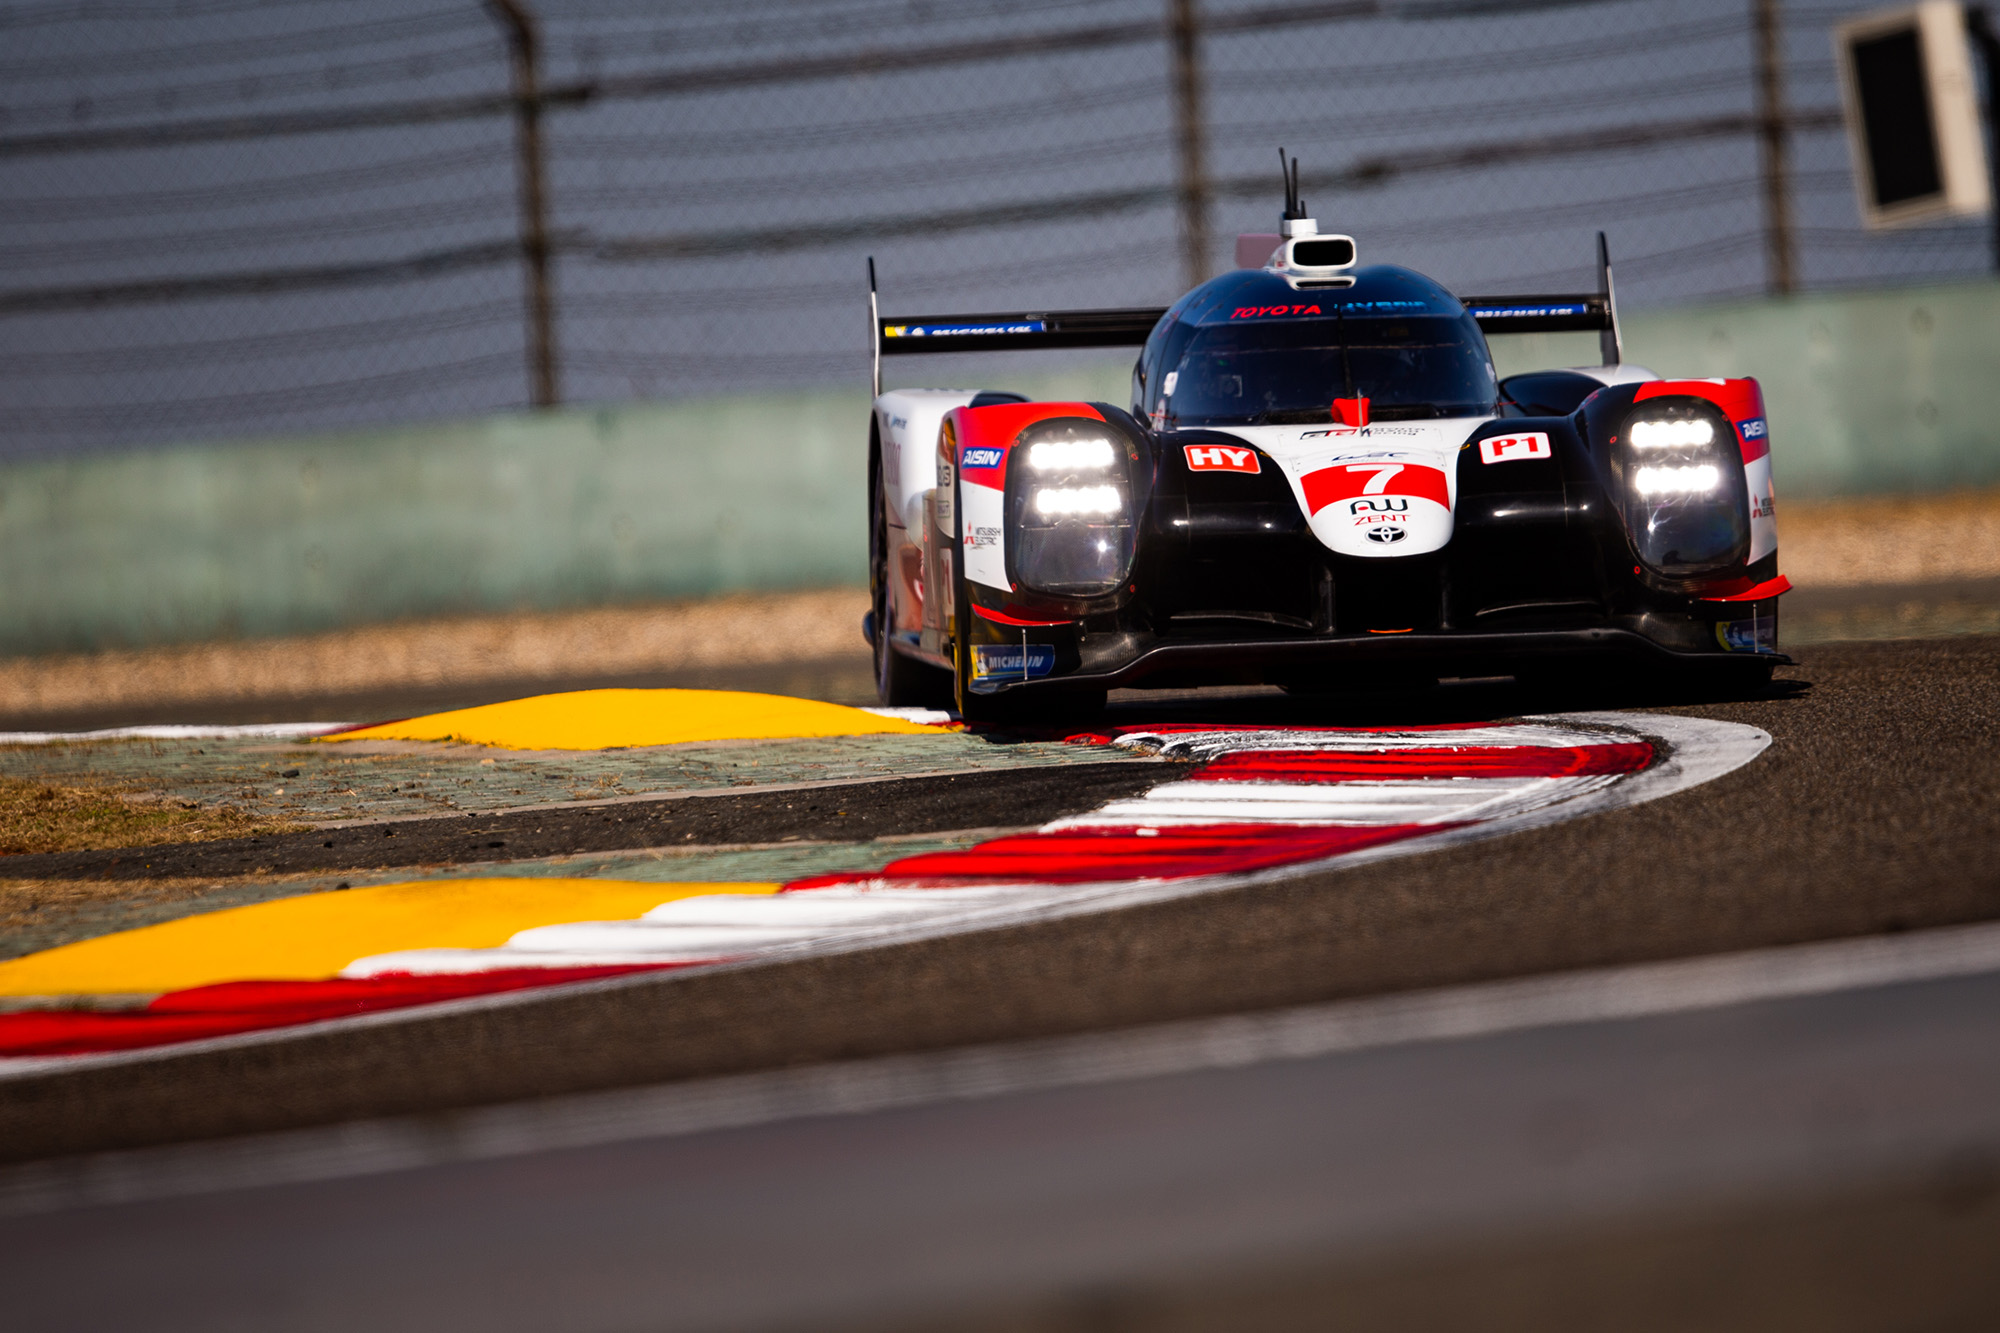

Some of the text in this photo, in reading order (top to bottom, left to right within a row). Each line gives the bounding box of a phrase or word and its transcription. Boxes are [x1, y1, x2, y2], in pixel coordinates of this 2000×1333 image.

[1231, 304, 1321, 319] TOYOTA
[1492, 436, 1539, 457] P1
[962, 450, 1001, 465] AISIN
[1190, 448, 1250, 467] HY
[1346, 464, 1405, 495] 7
[1353, 514, 1411, 526] ZENT
